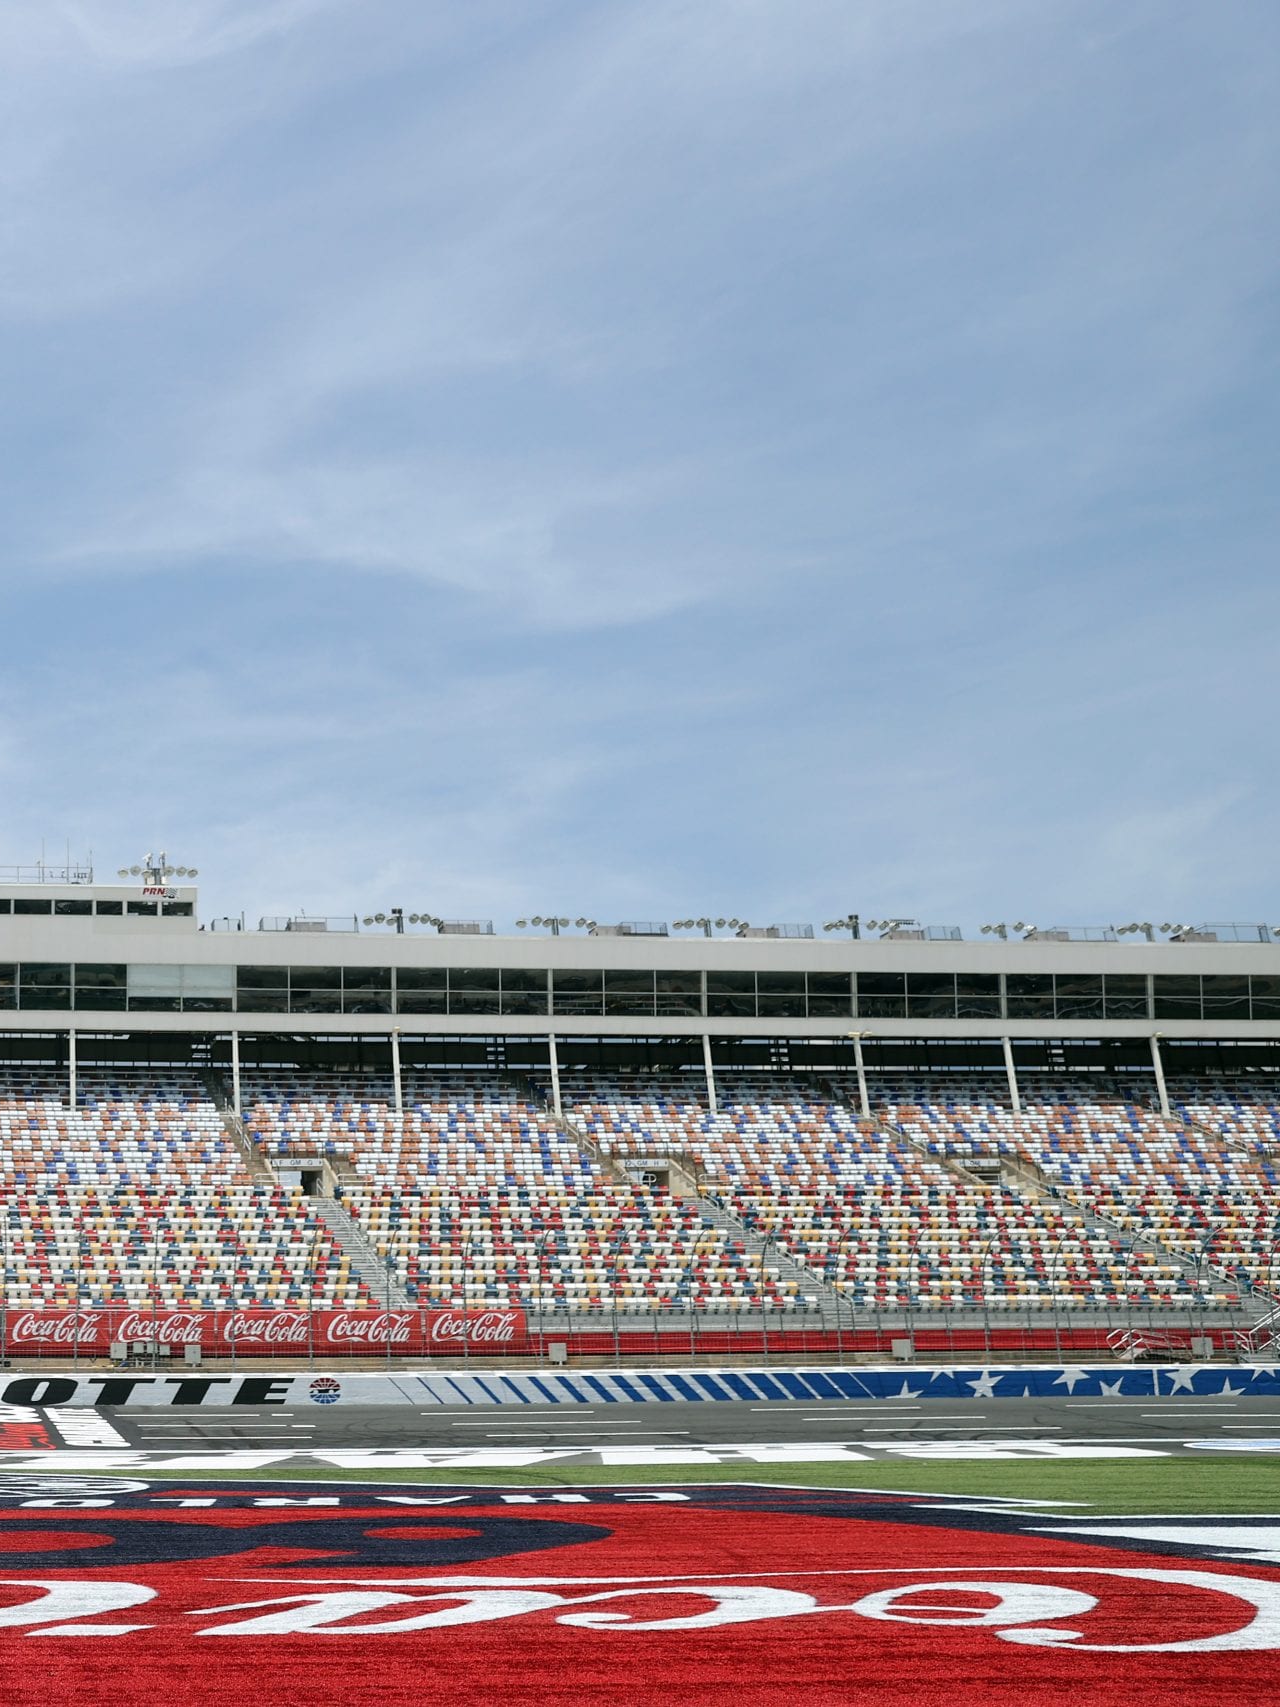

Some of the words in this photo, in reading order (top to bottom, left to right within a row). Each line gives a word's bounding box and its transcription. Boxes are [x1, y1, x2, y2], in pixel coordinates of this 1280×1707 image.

[143, 887, 166, 896] PRN
[11, 1311, 103, 1345] Coca-Cola
[117, 1311, 208, 1345] Coca-Cola
[224, 1311, 312, 1345] Coca-Cola
[327, 1311, 415, 1345] Coca-Cola
[432, 1311, 520, 1344] Coca-Cola
